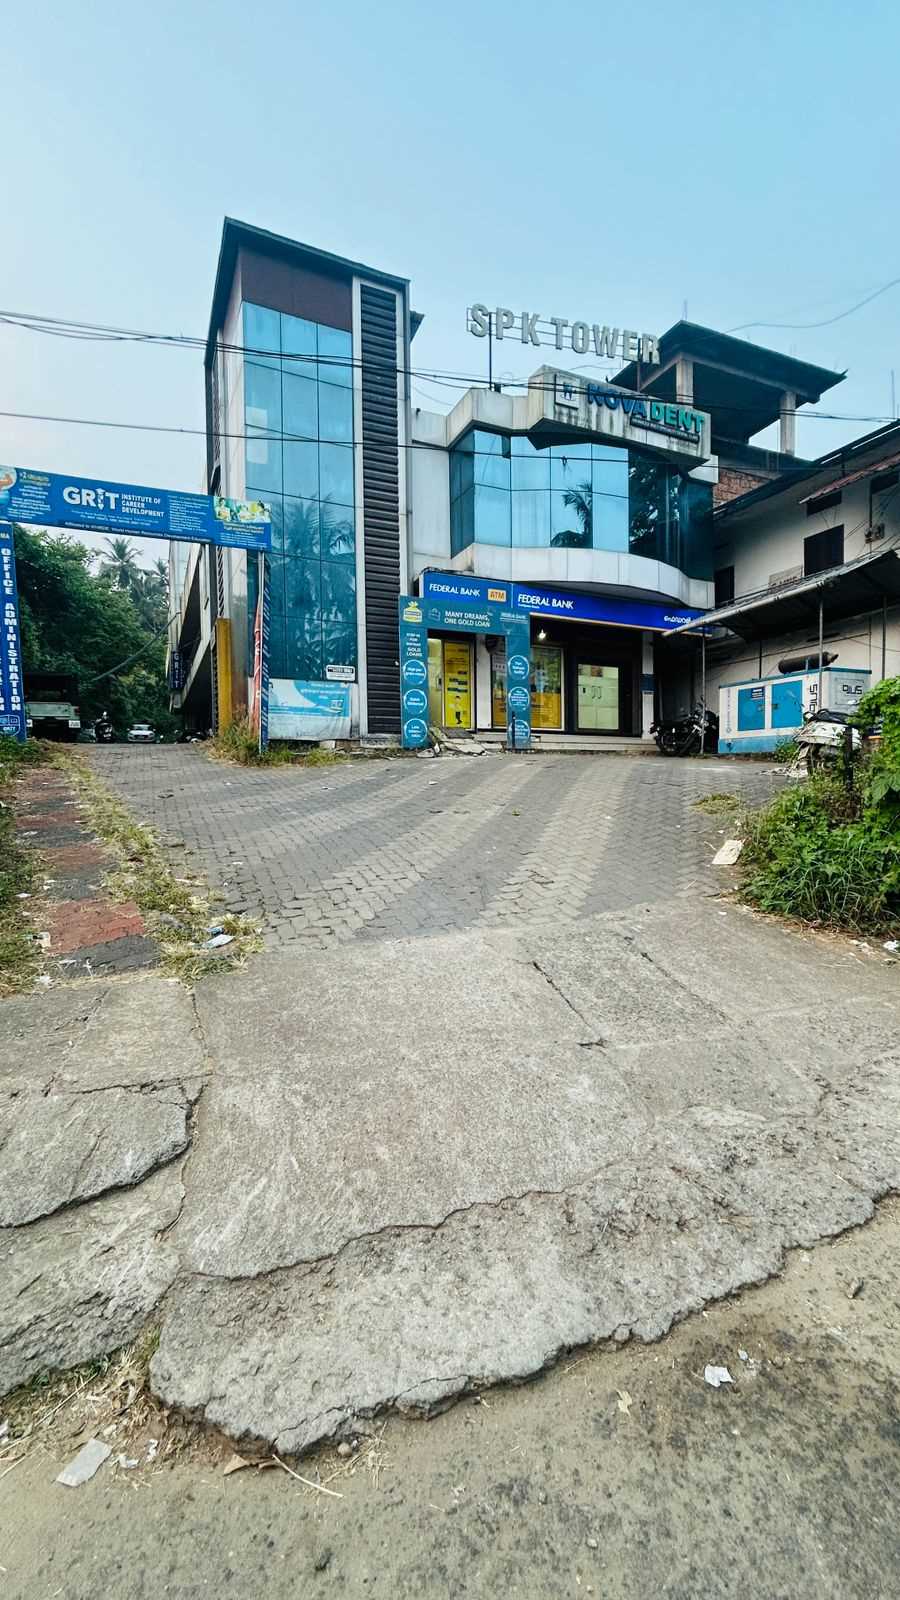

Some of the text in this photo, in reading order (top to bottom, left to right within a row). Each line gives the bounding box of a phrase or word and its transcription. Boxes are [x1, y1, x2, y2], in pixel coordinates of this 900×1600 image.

[469, 303, 660, 365] SPK TOWER
[121, 493, 152, 503] INSTITUTE
[121, 500, 145, 508] CAREER
[121, 506, 165, 517] DEVELOPMENT
[429, 583, 505, 601] FEDERAL BANK ATM
[518, 593, 549, 606] FEDERAL
[551, 598, 574, 609] BANK
[444, 610, 490, 622] MANY DREAMS,
[1, 548, 21, 711] OFFICE ADMINISTRATION
